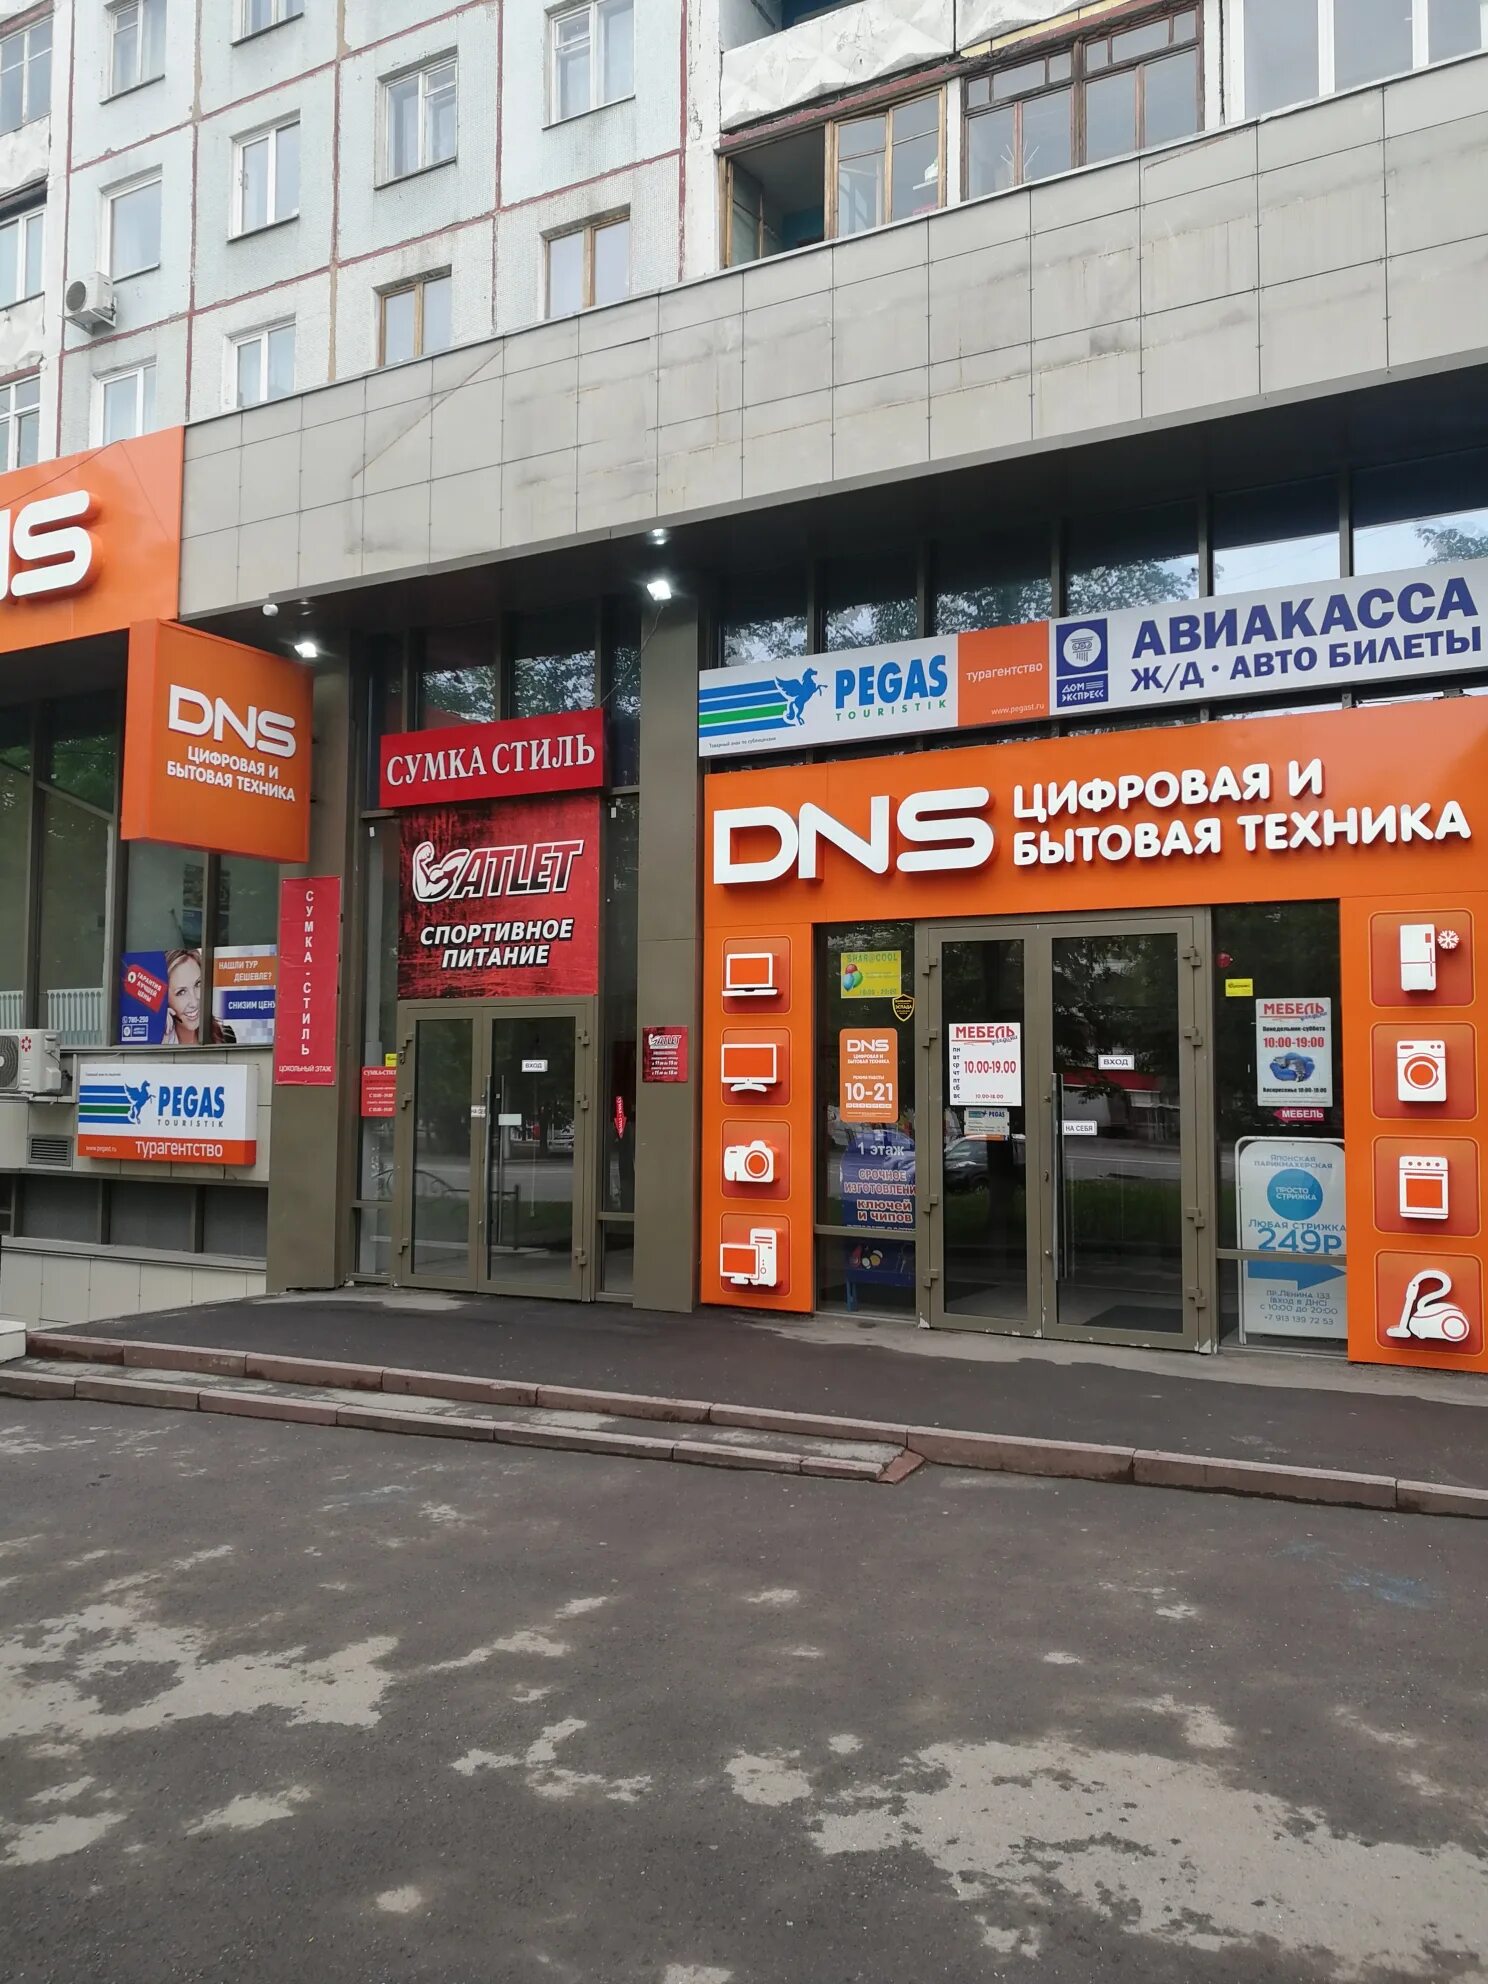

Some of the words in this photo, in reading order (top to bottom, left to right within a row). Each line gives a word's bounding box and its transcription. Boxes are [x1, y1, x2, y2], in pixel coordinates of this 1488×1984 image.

[0, 490, 92, 600] S
[1131, 577, 1478, 659] АВИАКАССА
[1130, 662, 1205, 693] Ж/Д
[1229, 646, 1317, 681] АВТО
[1328, 626, 1481, 668] БИЛЕТЫ
[835, 654, 948, 709] PEGAS
[966, 663, 1043, 683] турагентство
[1062, 682, 1085, 693] ДОМ
[1062, 689, 1104, 703] ЭКСПРЕСС
[836, 699, 947, 722] TOURISTIK
[991, 703, 1045, 715] www.pegast.ru
[168, 684, 296, 757] DNS
[188, 745, 265, 777] ЦИФРОВАЯ
[269, 764, 279, 780] И
[386, 745, 487, 786] СУМКА
[492, 733, 596, 775] СТИЛЬ
[167, 760, 233, 788] БЫТОВАЯ
[236, 776, 296, 801] ТЕХНИКА
[1014, 763, 1270, 823] ЦИФРОВАЯ
[1288, 758, 1323, 796] И
[714, 786, 994, 884] DNS
[1014, 817, 1221, 865] БЫТОВАЯ
[1237, 800, 1471, 851] ТЕХНИКА
[420, 918, 574, 947] СПОРТИВНОЕ
[219, 961, 244, 969] НАШЛИ
[245, 960, 258, 969] ТУР
[441, 944, 549, 968] ПИТАНИЕ
[137, 972, 162, 992] ГАРАНТИЯ
[234, 972, 272, 982] ДЕШЕВЛЕ?
[228, 1001, 257, 1010] СНИЗИМ
[1264, 1002, 1325, 1015] МЕБЕЛЬ
[956, 1026, 1015, 1039] МЕБЕЛЬ
[847, 1039, 890, 1052] DNS
[1263, 1037, 1325, 1048] 10:00-19:00
[964, 1061, 1016, 1074] 10.00-19.00
[845, 1082, 893, 1102] 10-21
[158, 1085, 225, 1119] PEGAS
[1281, 1109, 1324, 1119] МЕБЕЛЬ
[158, 1119, 224, 1128] TOURISTIK
[135, 1140, 223, 1158] турагентство
[857, 1142, 865, 1155] 1
[870, 1144, 905, 1156] этаж
[858, 1168, 907, 1182] СРОЧНОЕ
[1275, 1186, 1309, 1194] ПРОСТО
[1275, 1192, 1317, 1201] СТРИЖКА
[1292, 1221, 1346, 1232] СТРИЖКА
